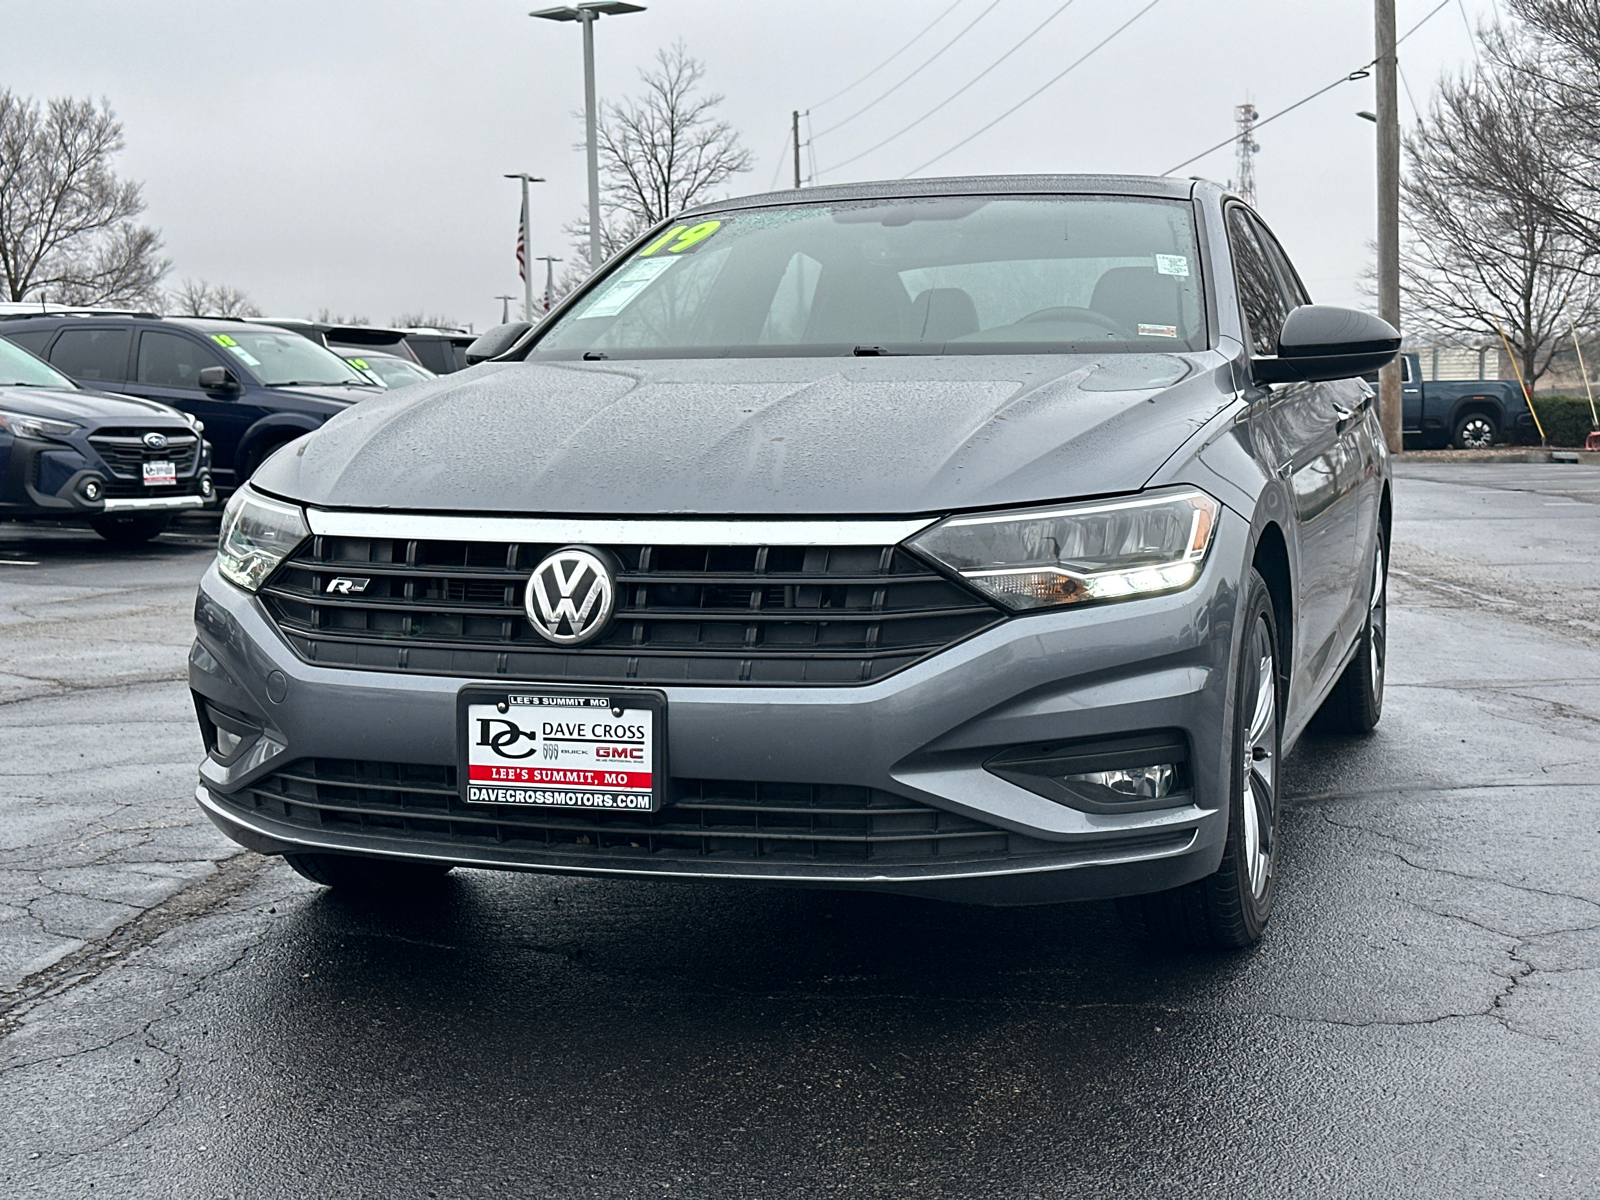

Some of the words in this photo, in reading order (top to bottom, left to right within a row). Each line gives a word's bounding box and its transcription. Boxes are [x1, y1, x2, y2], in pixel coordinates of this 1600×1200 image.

[639, 220, 721, 257] 19
[510, 696, 539, 705] LEE'S
[542, 697, 586, 706] SUMMIT
[590, 699, 608, 707] MO
[476, 718, 537, 760] DC
[542, 722, 586, 737] DAVE
[591, 724, 645, 739] CROSS
[595, 746, 644, 759] GMC
[534, 770, 599, 785] SUMMIT,
[604, 773, 628, 785] MO
[470, 788, 650, 809] DAVECROSSMOTORS.COM
